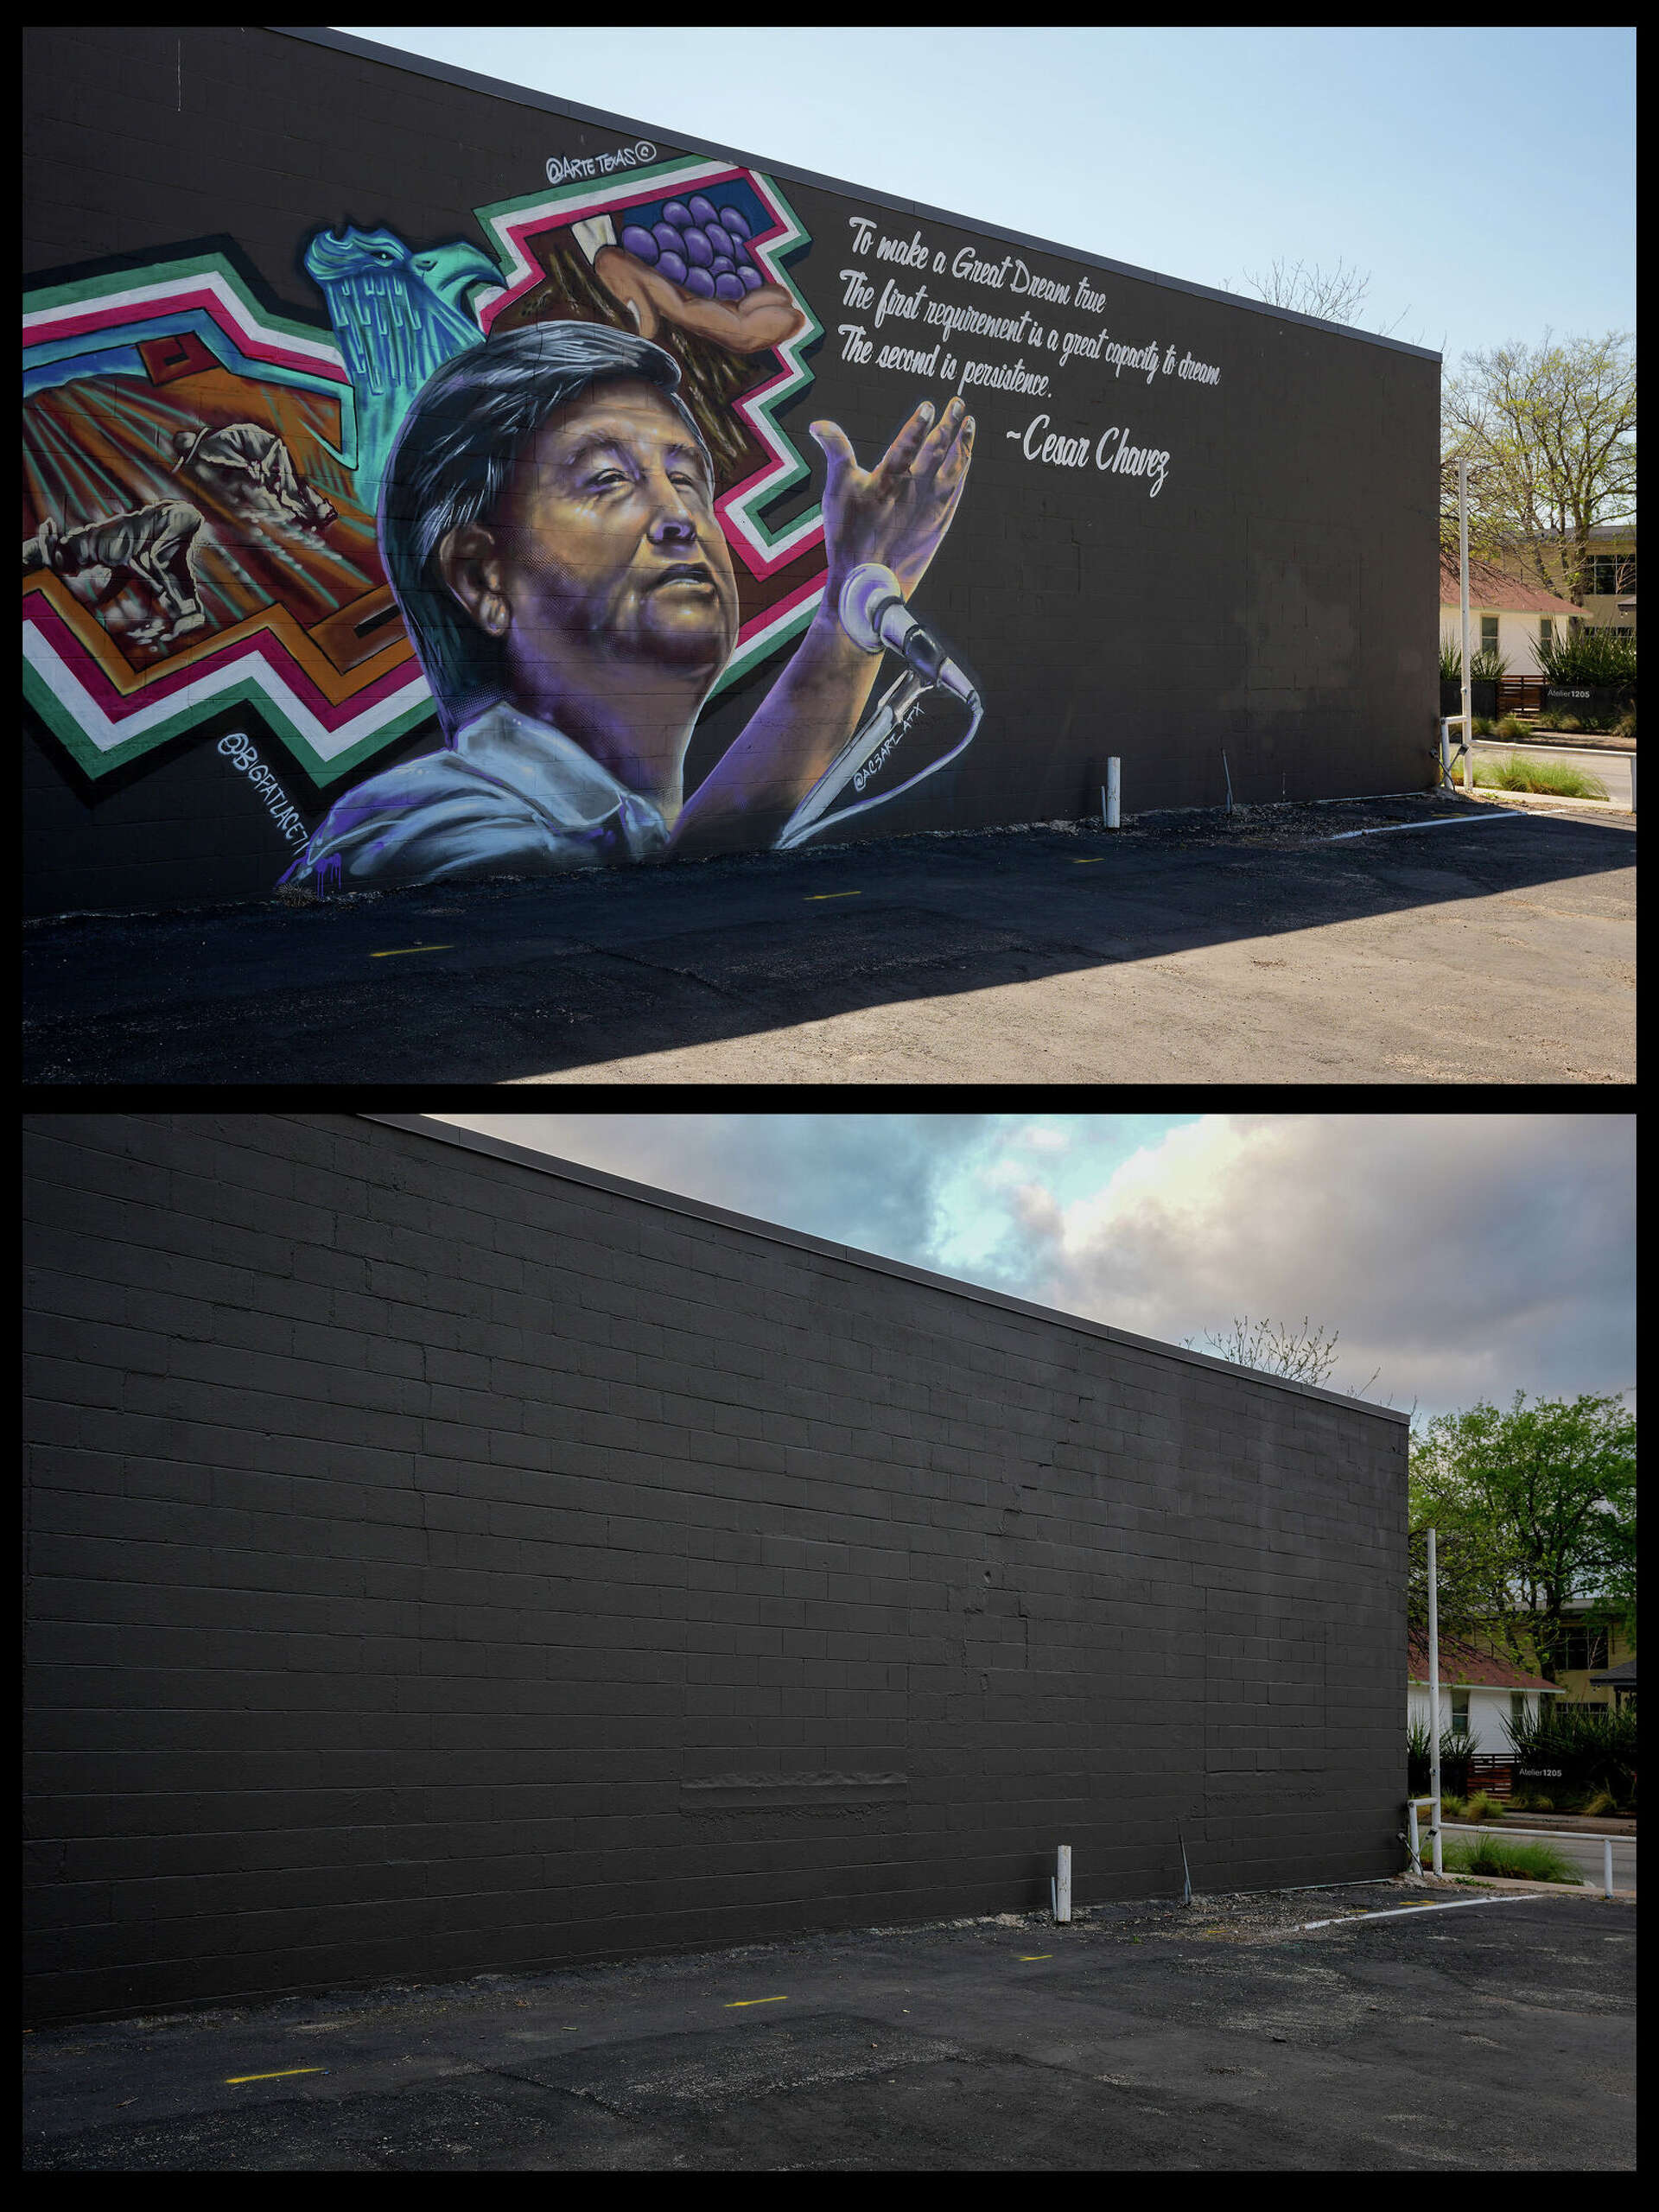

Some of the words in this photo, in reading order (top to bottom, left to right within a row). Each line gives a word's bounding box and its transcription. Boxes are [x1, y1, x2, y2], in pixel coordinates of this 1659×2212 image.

[849, 216, 878, 255] To
[876, 231, 929, 270] make
[932, 251, 947, 275] a
[951, 246, 1014, 289] Great
[1009, 259, 1071, 306] Dream
[1074, 276, 1107, 314] true
[837, 323, 874, 365] The
[874, 344, 941, 378] second
[939, 353, 958, 381] is
[957, 358, 1052, 398] persistence.
[839, 269, 875, 310] The
[874, 278, 929, 329] first
[923, 300, 1033, 344] requirement
[1027, 321, 1043, 348] is
[1046, 327, 1059, 352] a
[1058, 327, 1109, 367] great
[1104, 340, 1160, 385] capacity
[1161, 344, 1179, 375] to
[1178, 351, 1221, 386] dream
[1095, 426, 1171, 499] Chavez
